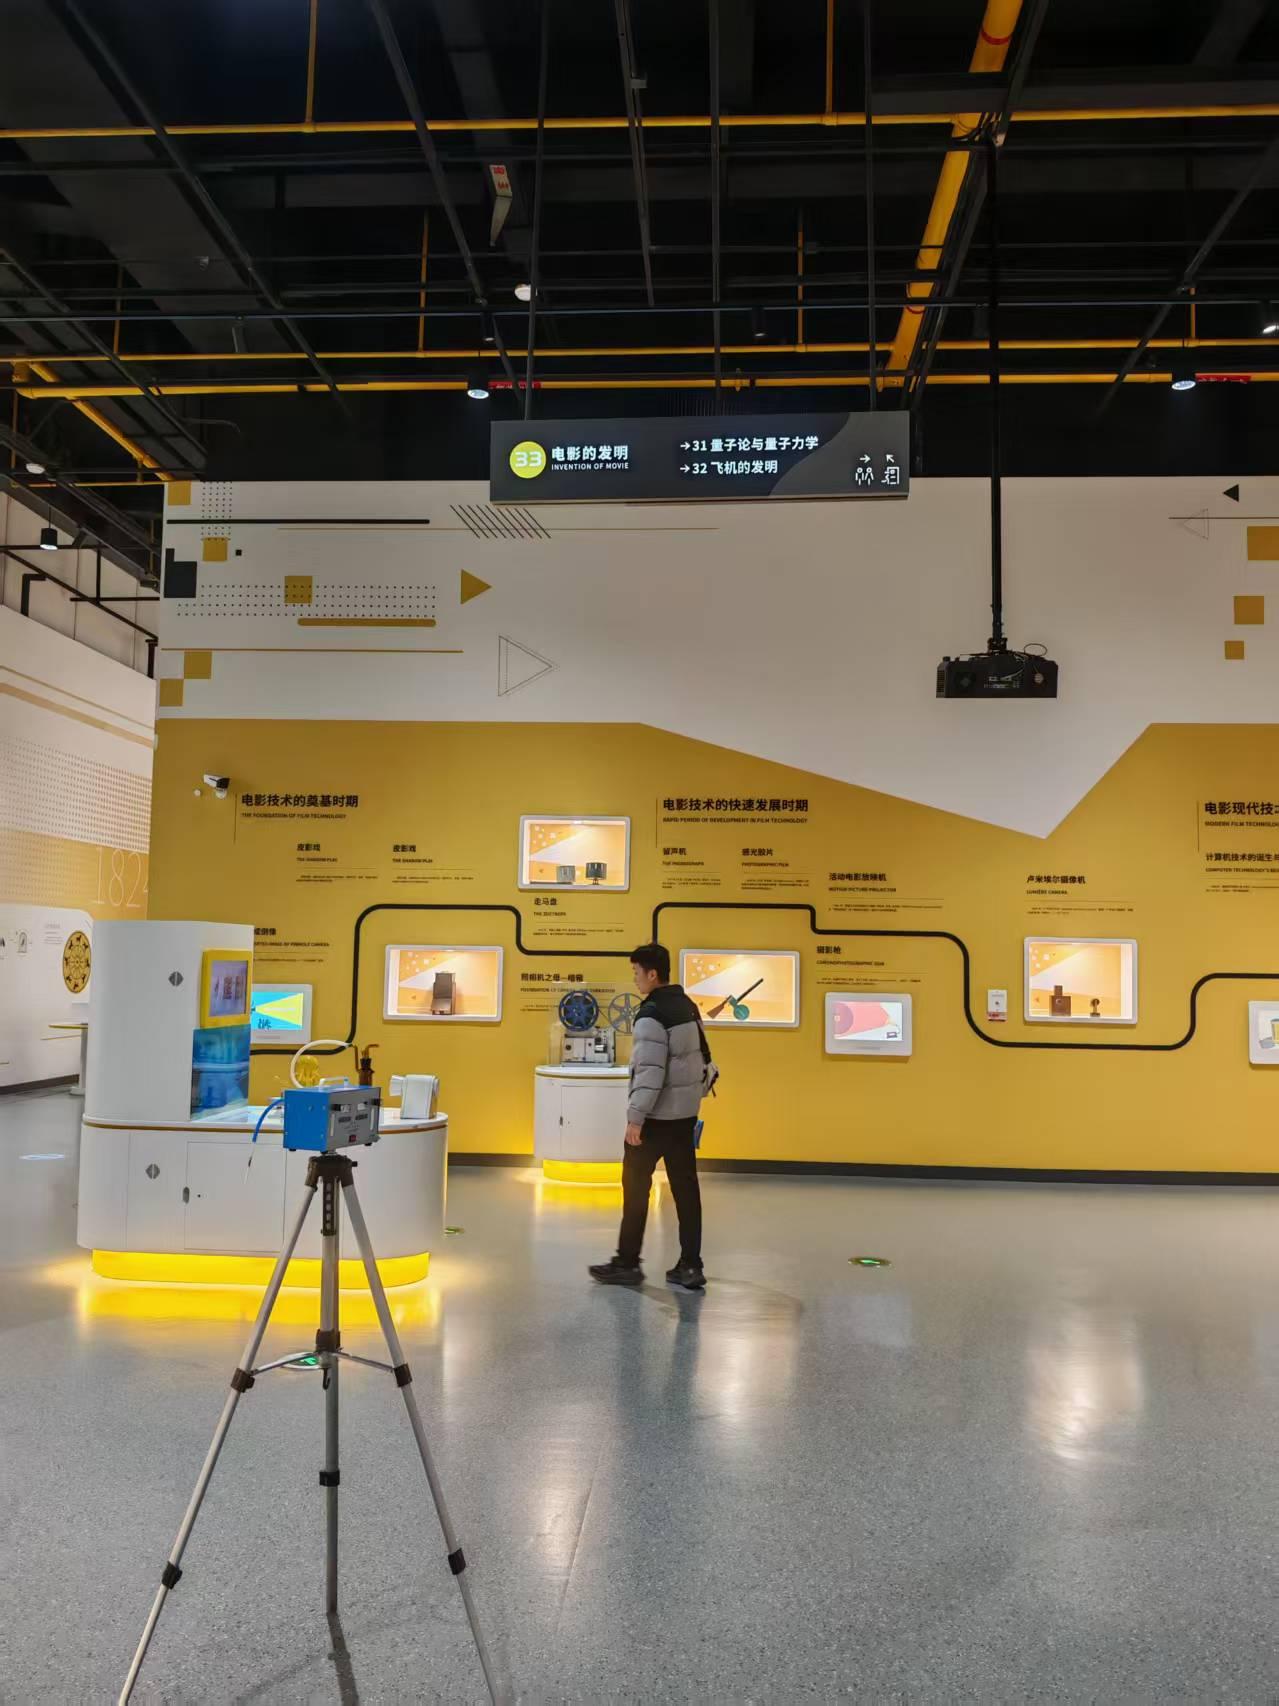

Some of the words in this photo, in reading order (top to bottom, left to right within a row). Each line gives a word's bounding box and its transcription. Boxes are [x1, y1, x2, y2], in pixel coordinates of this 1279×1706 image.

[692, 440, 707, 451] 31
[711, 436, 819, 452] 量子论与量子力学
[515, 451, 542, 468] 33
[551, 445, 629, 461] 电影的发明
[551, 463, 591, 471] INVENTION
[606, 462, 629, 470] MOVIE
[692, 463, 708, 474] 32
[711, 460, 778, 474] 飞机的发明
[242, 794, 359, 808] 电影技术的奠基时期
[663, 798, 809, 812] 电影技术的快速发展时期
